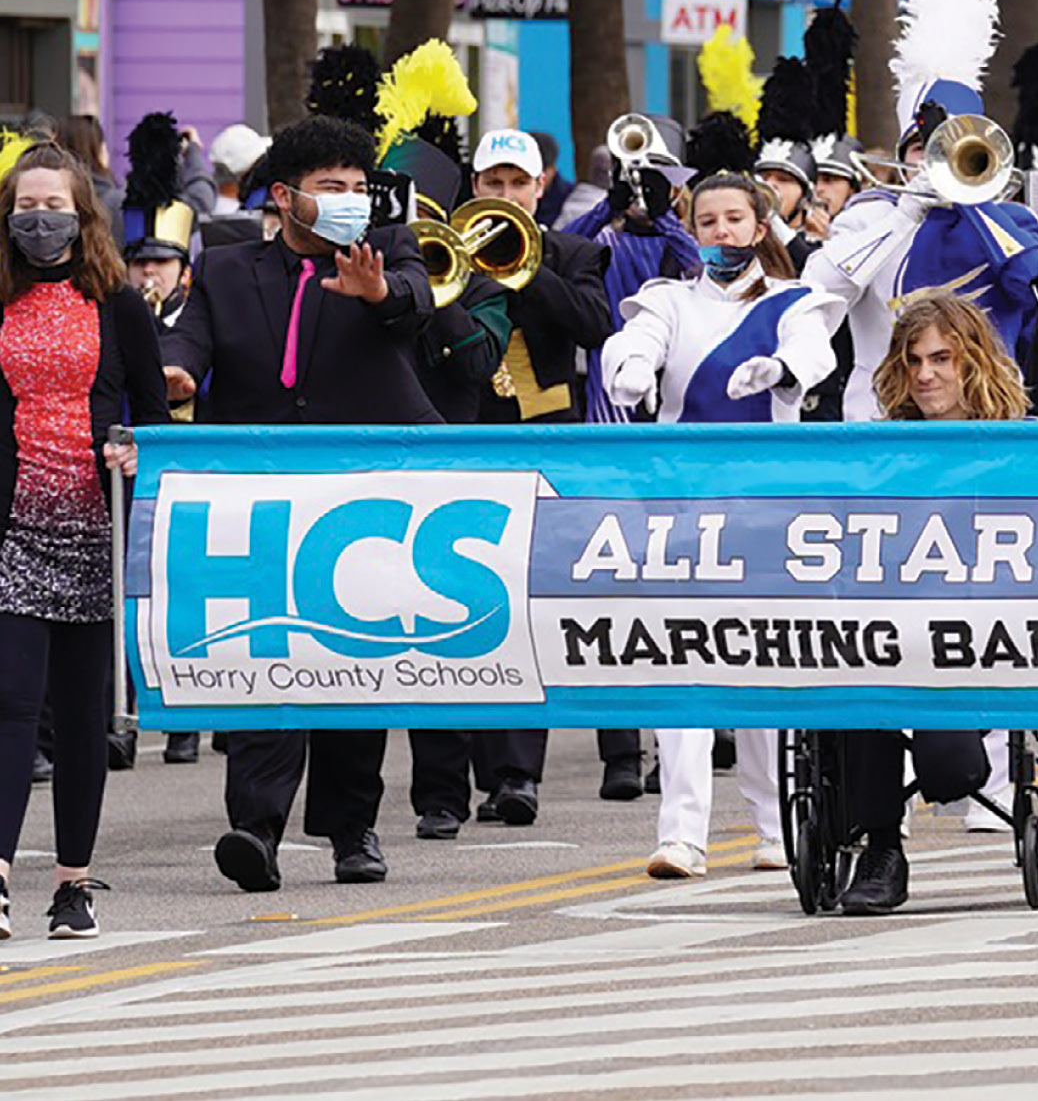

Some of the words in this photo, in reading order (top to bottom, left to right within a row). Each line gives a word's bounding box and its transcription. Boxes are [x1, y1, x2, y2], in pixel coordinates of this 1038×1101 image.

[673, 6, 737, 31] ATM
[491, 136, 527, 151] HCS
[572, 513, 744, 582] ALL
[784, 513, 1036, 583] STAR
[167, 498, 512, 659] HCS
[560, 617, 902, 668] MARCHING
[171, 664, 257, 694] Horry
[268, 663, 386, 692] County
[395, 660, 523, 688] Schools
